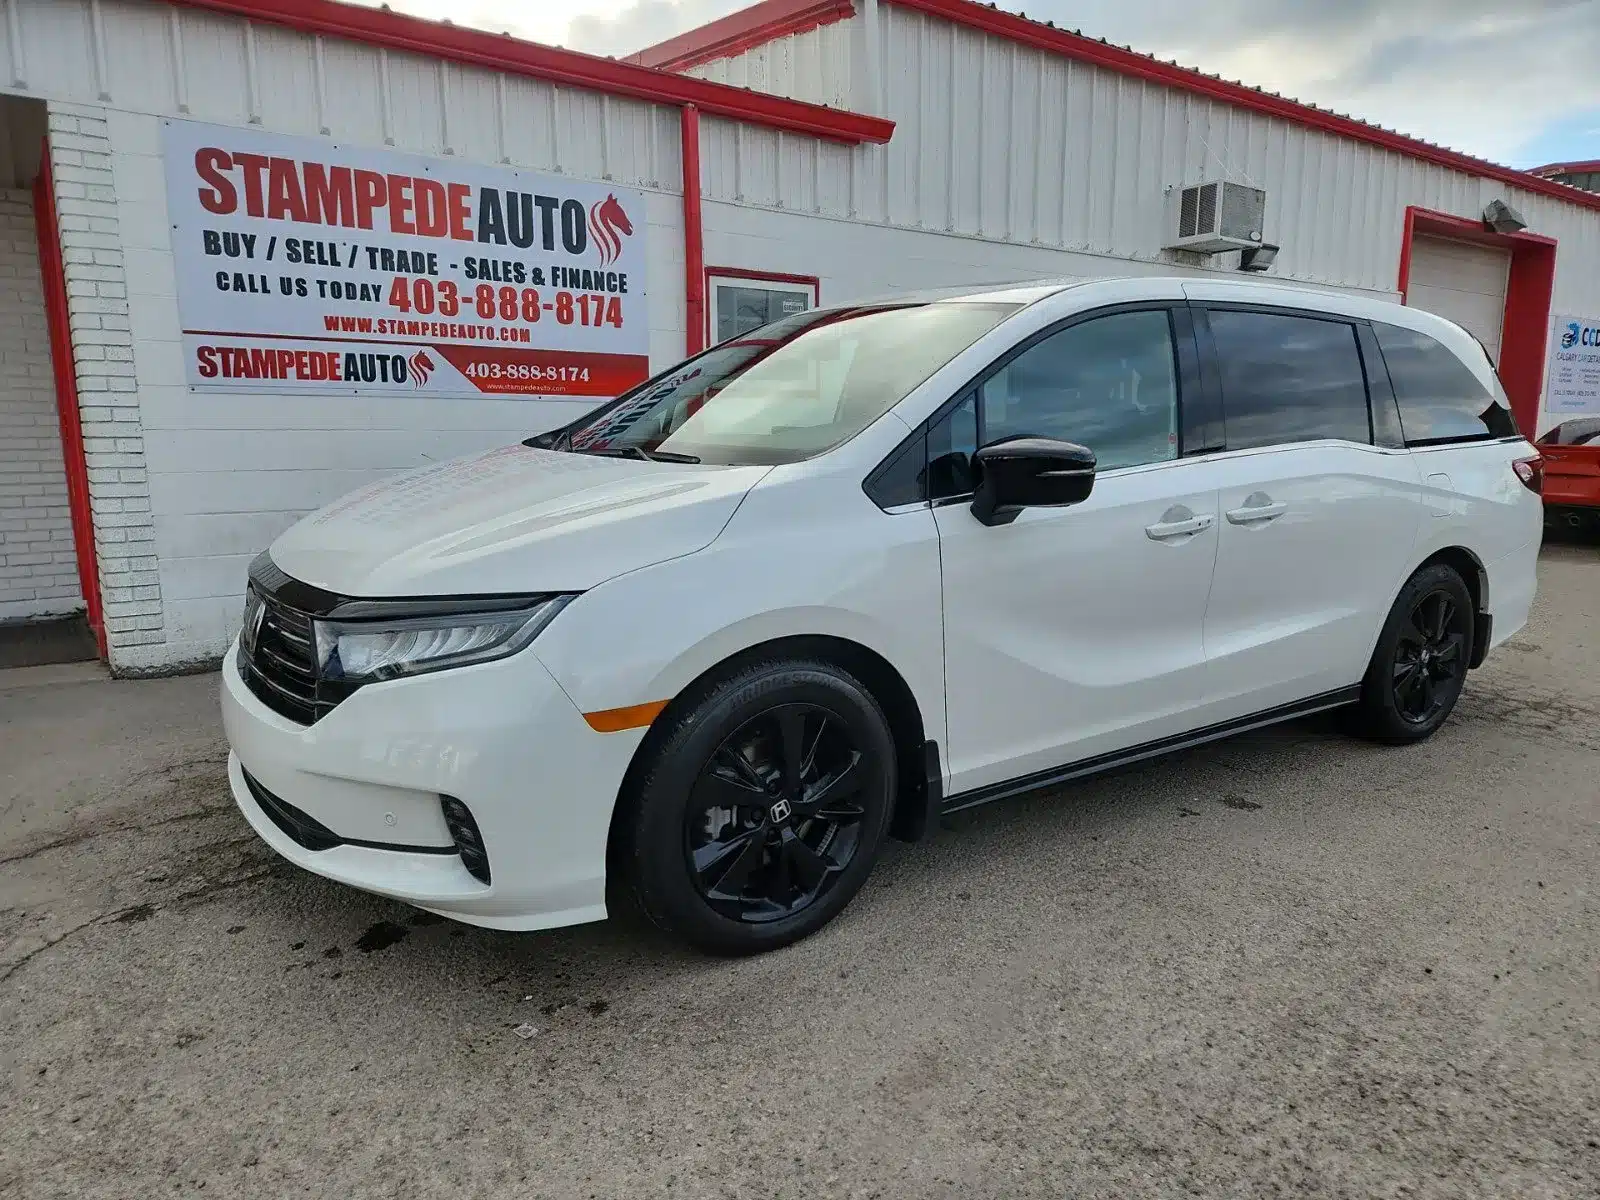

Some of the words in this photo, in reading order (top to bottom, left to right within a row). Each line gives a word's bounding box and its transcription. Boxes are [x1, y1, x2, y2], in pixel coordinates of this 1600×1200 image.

[202, 229, 257, 259] BUY
[266, 236, 277, 261] /
[286, 238, 341, 267] SELL
[348, 245, 359, 268] /
[365, 246, 439, 276] TRADE
[464, 256, 527, 284] SALES
[532, 266, 546, 286] &
[551, 266, 628, 294] FINANCE
[215, 271, 271, 294] CALL
[280, 276, 308, 297] US
[316, 279, 382, 302] TODAY
[388, 276, 624, 328] 403-888-8174
[323, 315, 531, 343] WWW.STAMPEDEAUTO.COM
[465, 362, 590, 382] 403-888-8174
[486, 383, 567, 392] www.stampedeauto.com
